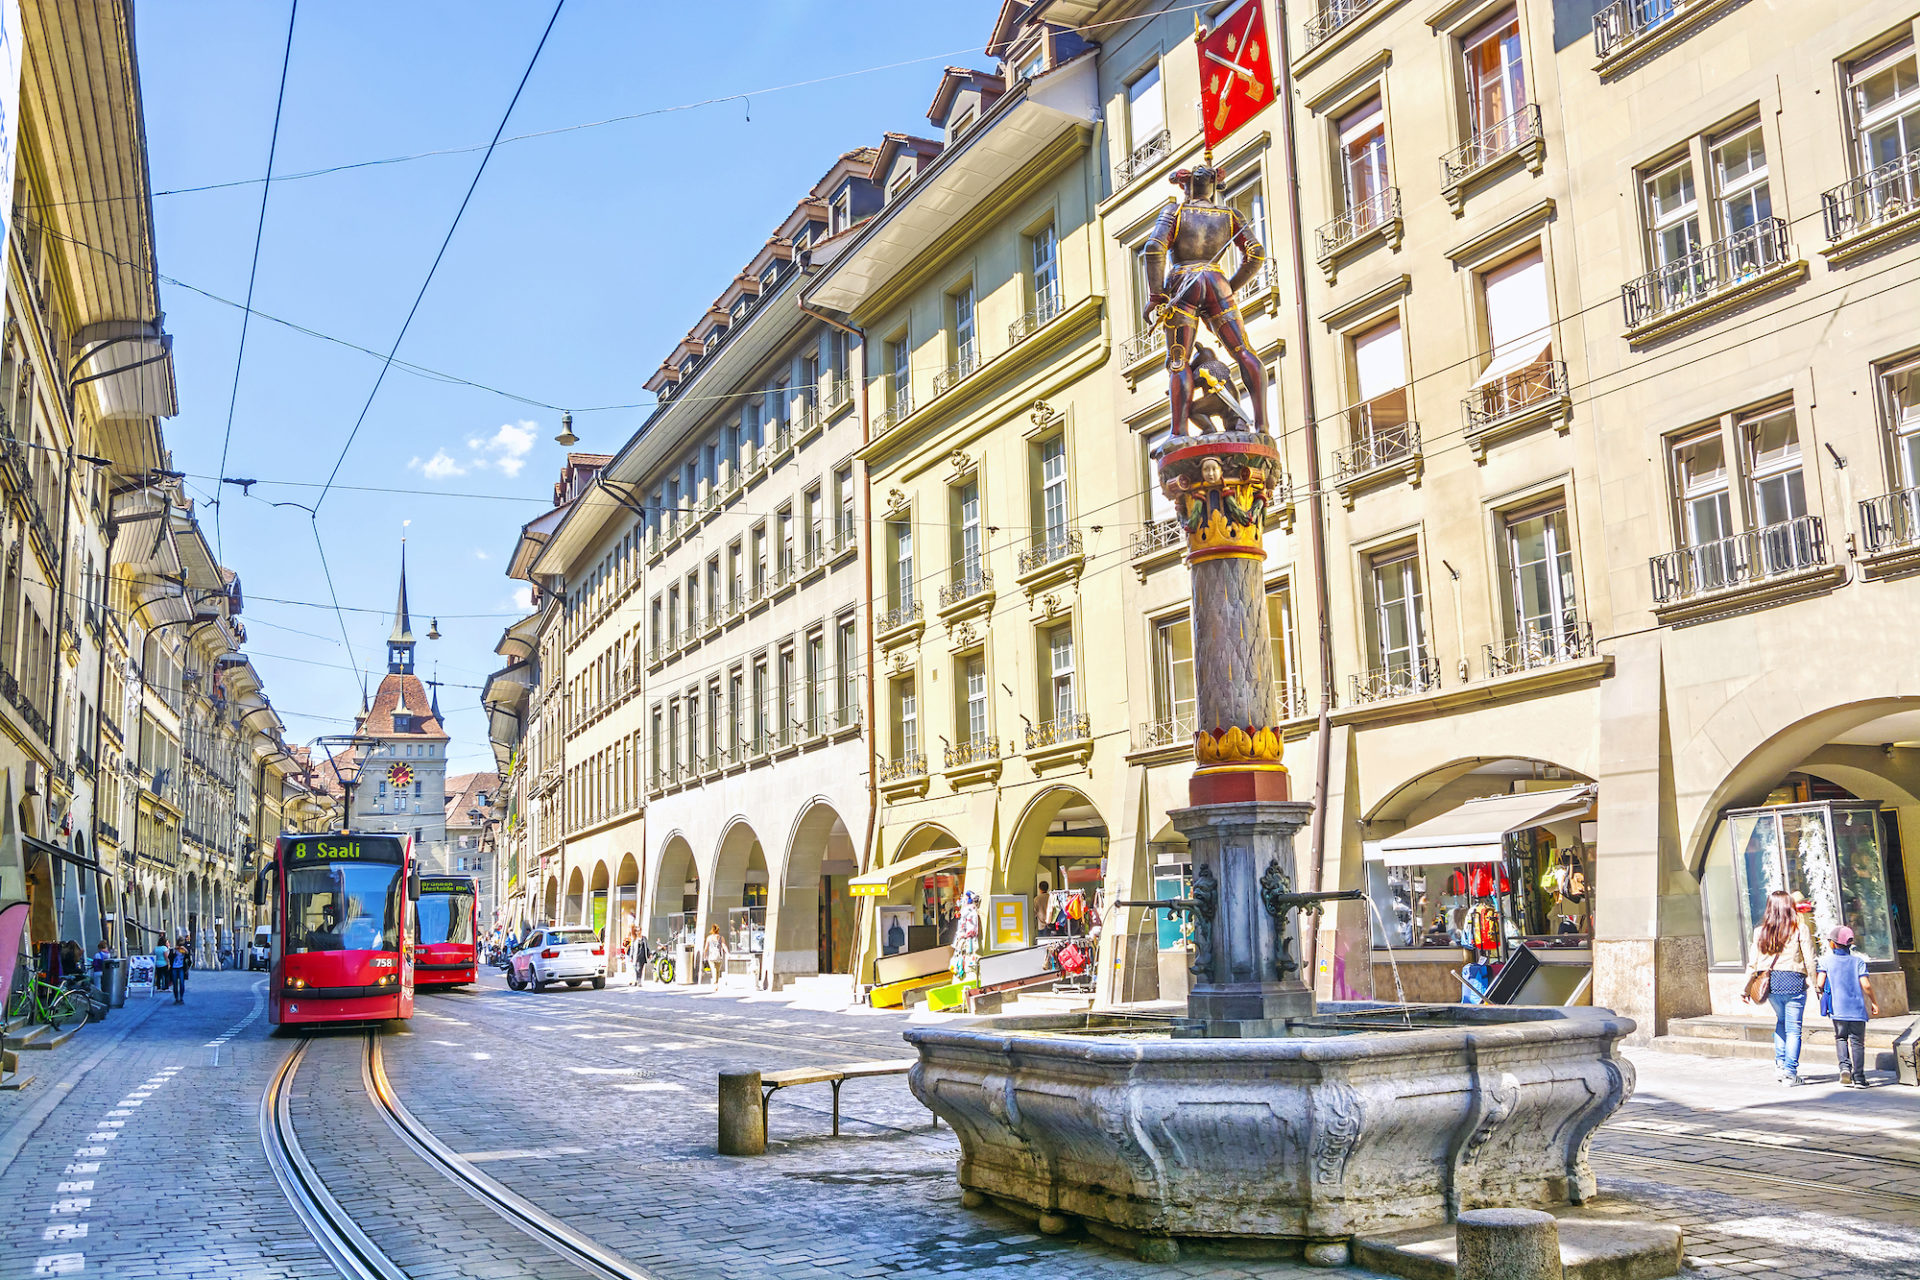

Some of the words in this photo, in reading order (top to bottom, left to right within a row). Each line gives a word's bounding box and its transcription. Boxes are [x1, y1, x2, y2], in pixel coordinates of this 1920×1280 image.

[296, 842, 306, 858] 8
[317, 842, 360, 858] Saali
[375, 958, 392, 968] 758
